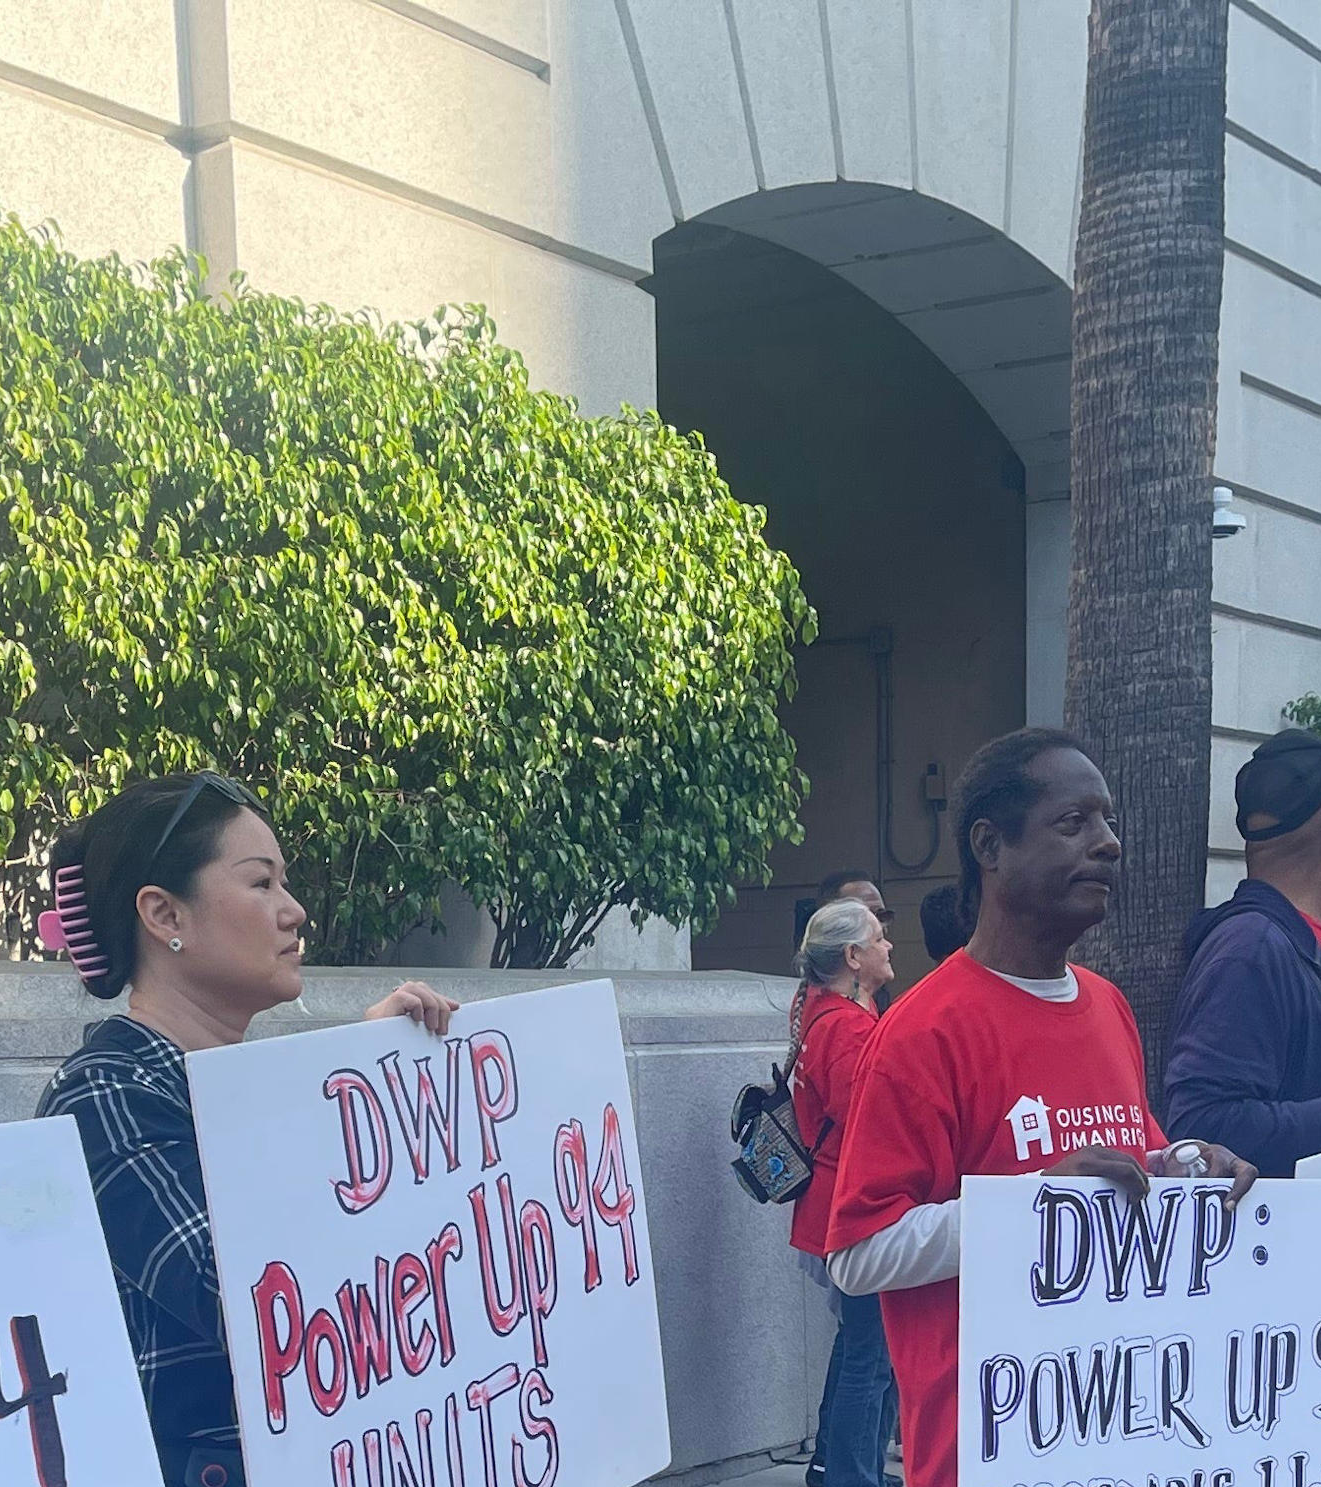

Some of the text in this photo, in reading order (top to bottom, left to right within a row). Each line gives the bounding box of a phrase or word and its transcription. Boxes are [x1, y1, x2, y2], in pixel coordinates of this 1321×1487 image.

[323, 1029, 518, 1214] DWP
[251, 1103, 640, 1434] Power Up 94
[1030, 1182, 1270, 1307] DWP:
[979, 1334, 1212, 1463] POWER
[1224, 1322, 1301, 1440] UP
